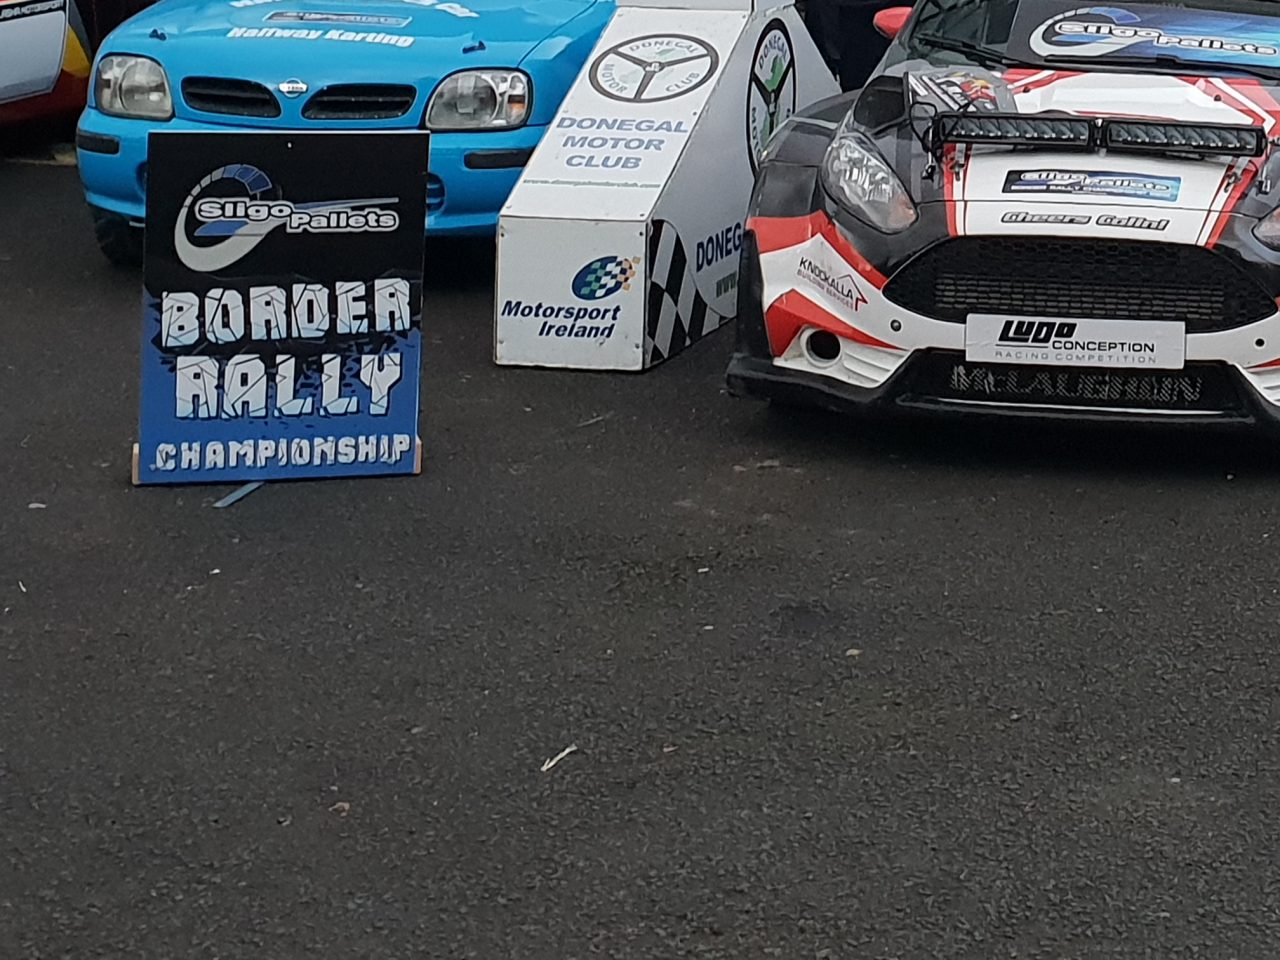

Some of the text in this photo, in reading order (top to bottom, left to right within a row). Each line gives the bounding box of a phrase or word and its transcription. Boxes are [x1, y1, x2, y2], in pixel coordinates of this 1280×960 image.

[227, 27, 415, 47] Halfway Karting
[629, 40, 699, 54] DONEGAL
[759, 34, 788, 70] DONEGAL
[603, 63, 628, 93] MOTOR
[665, 71, 700, 92] CLUB
[556, 117, 688, 133] DONEGAL
[562, 136, 665, 151] MOTOR
[566, 155, 642, 169] CLUB
[195, 197, 399, 232] Sligo Pallets
[1003, 212, 1091, 224] Cheers
[696, 222, 742, 273] DONEG
[799, 256, 853, 300] KNOCKALLA
[162, 278, 411, 347] BORDER
[501, 300, 621, 322] Motorsport
[538, 320, 616, 338] Ireland
[995, 351, 1157, 364] RACING COMPETITION
[1052, 341, 1155, 353] CONCEPTION
[175, 353, 402, 419] RALLY
[154, 434, 411, 471] CHAMPIONSHIP
